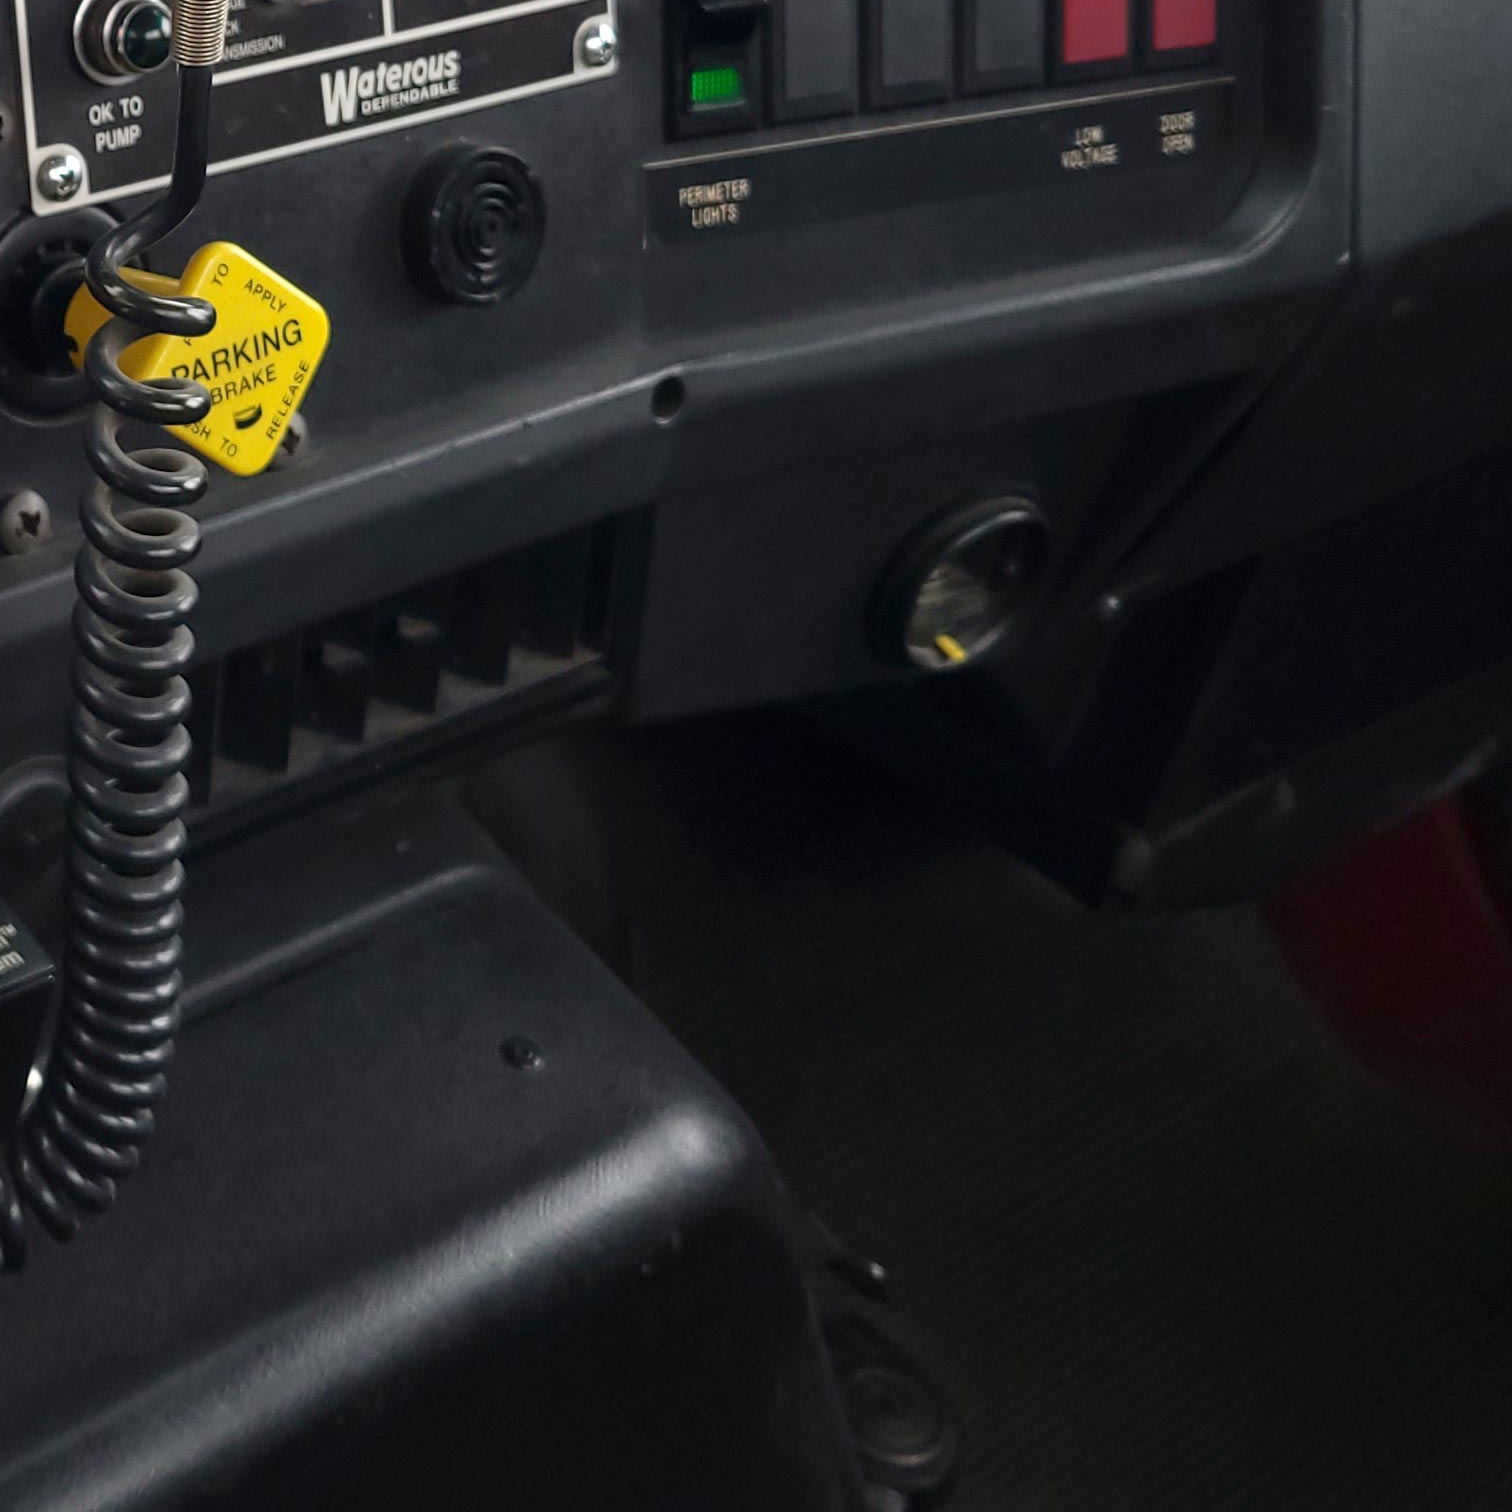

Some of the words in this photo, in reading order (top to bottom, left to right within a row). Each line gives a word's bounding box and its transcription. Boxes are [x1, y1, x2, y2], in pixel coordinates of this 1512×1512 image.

[321, 50, 461, 126] Waterous
[362, 80, 460, 115] DEPENDABLE
[89, 102, 114, 126] OK
[119, 96, 143, 118] TO
[96, 126, 141, 153] PUMP
[679, 178, 750, 208] PERIMETER
[692, 203, 739, 228] LIGHTS
[212, 263, 229, 287] TO
[244, 279, 287, 313] APPLY
[172, 319, 302, 380] PARKING
[211, 364, 277, 405] BRAKE
[220, 437, 237, 457] TO
[266, 360, 310, 440] RELEASE
